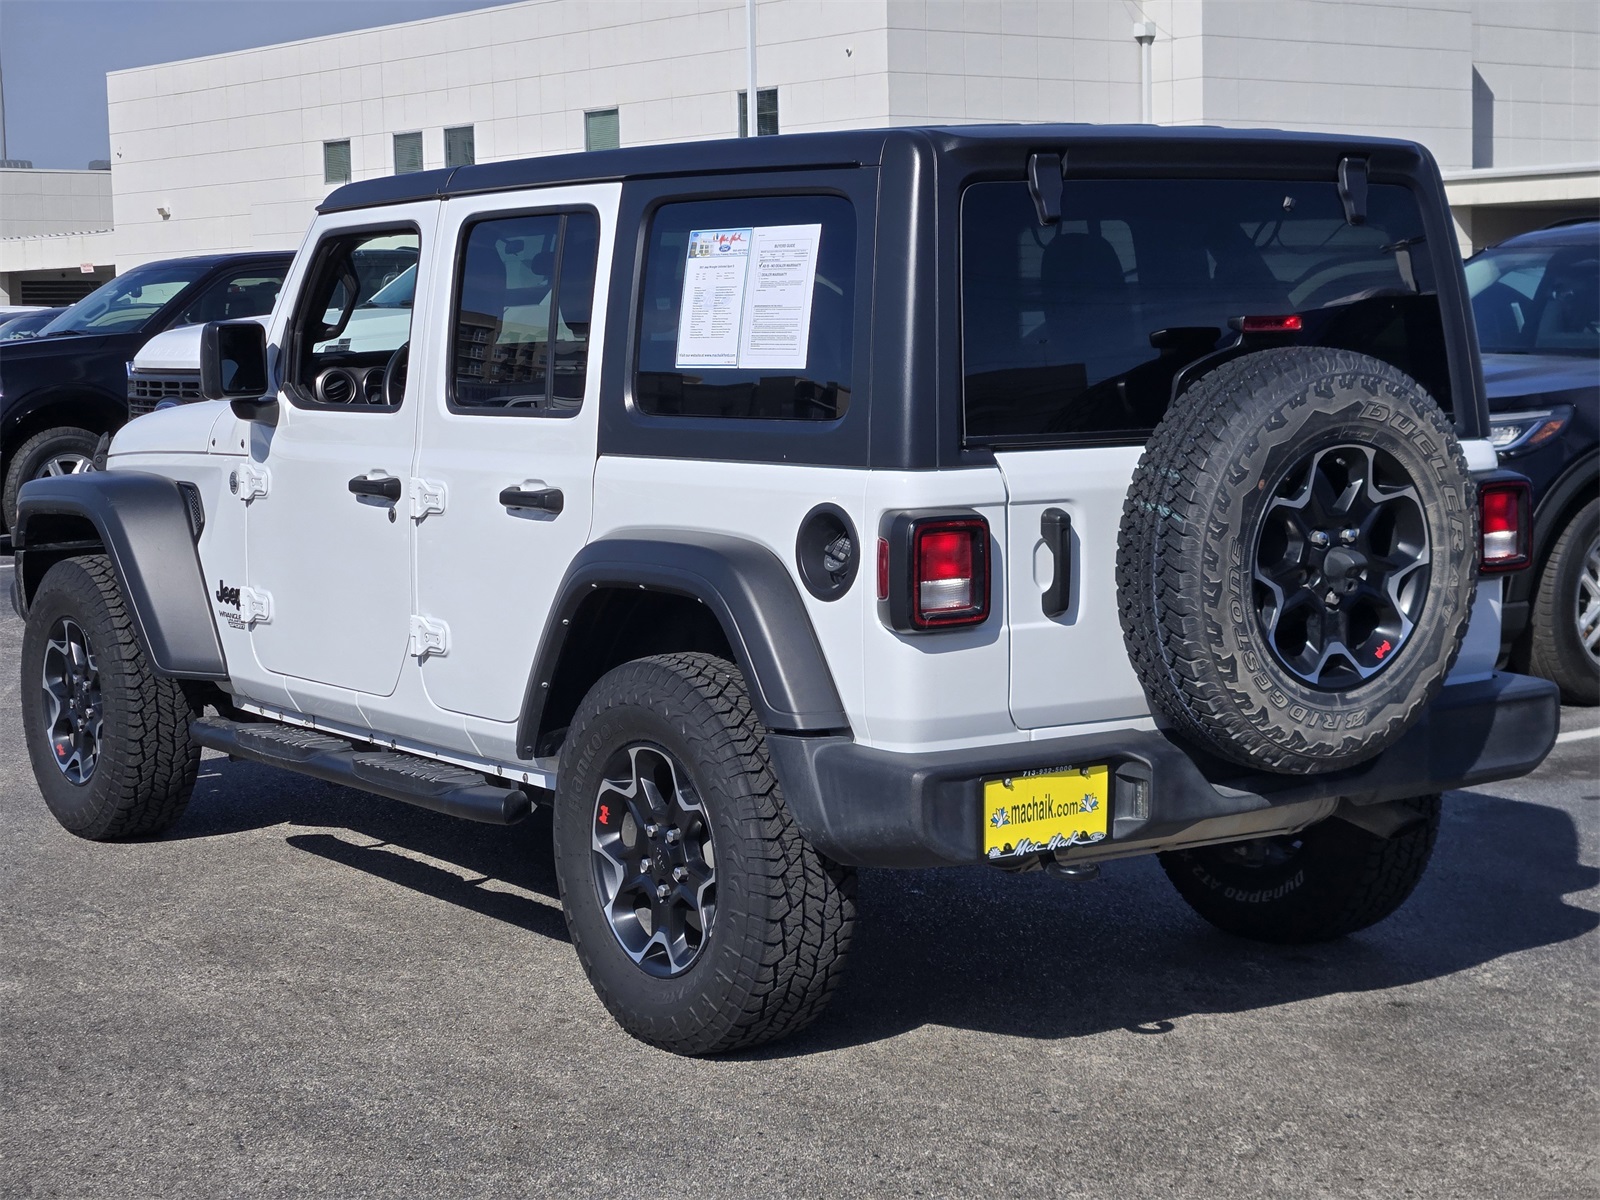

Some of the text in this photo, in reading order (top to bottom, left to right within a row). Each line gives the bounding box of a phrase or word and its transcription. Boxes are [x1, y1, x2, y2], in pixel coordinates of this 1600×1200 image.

[1359, 401, 1467, 552] DUELER
[1228, 536, 1368, 731] BRIDGESTONE
[1022, 765, 1073, 777] 713-932-5000
[1011, 794, 1079, 825] machaik.com
[1013, 837, 1046, 857] Mac
[1046, 831, 1083, 851] Haik
